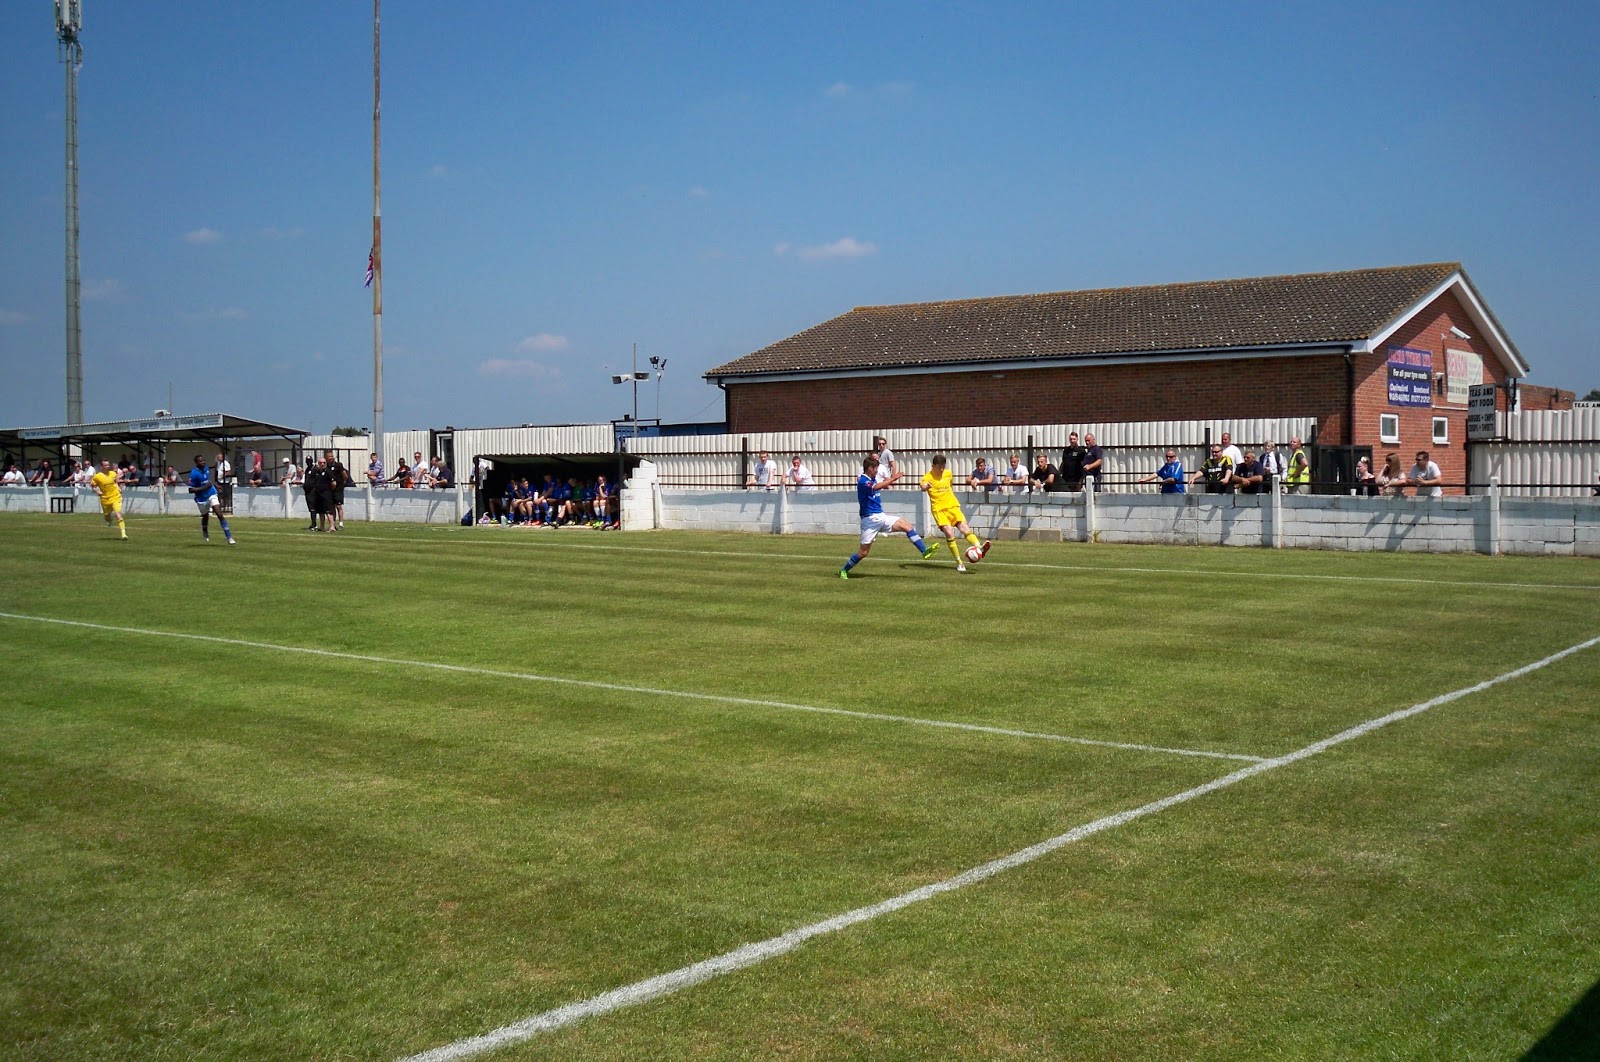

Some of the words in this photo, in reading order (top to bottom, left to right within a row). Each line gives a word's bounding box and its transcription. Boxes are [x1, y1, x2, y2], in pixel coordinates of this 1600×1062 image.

[1469, 389, 1481, 398] TEAS
[1483, 387, 1494, 396] AND
[1479, 398, 1494, 407] FOOD
